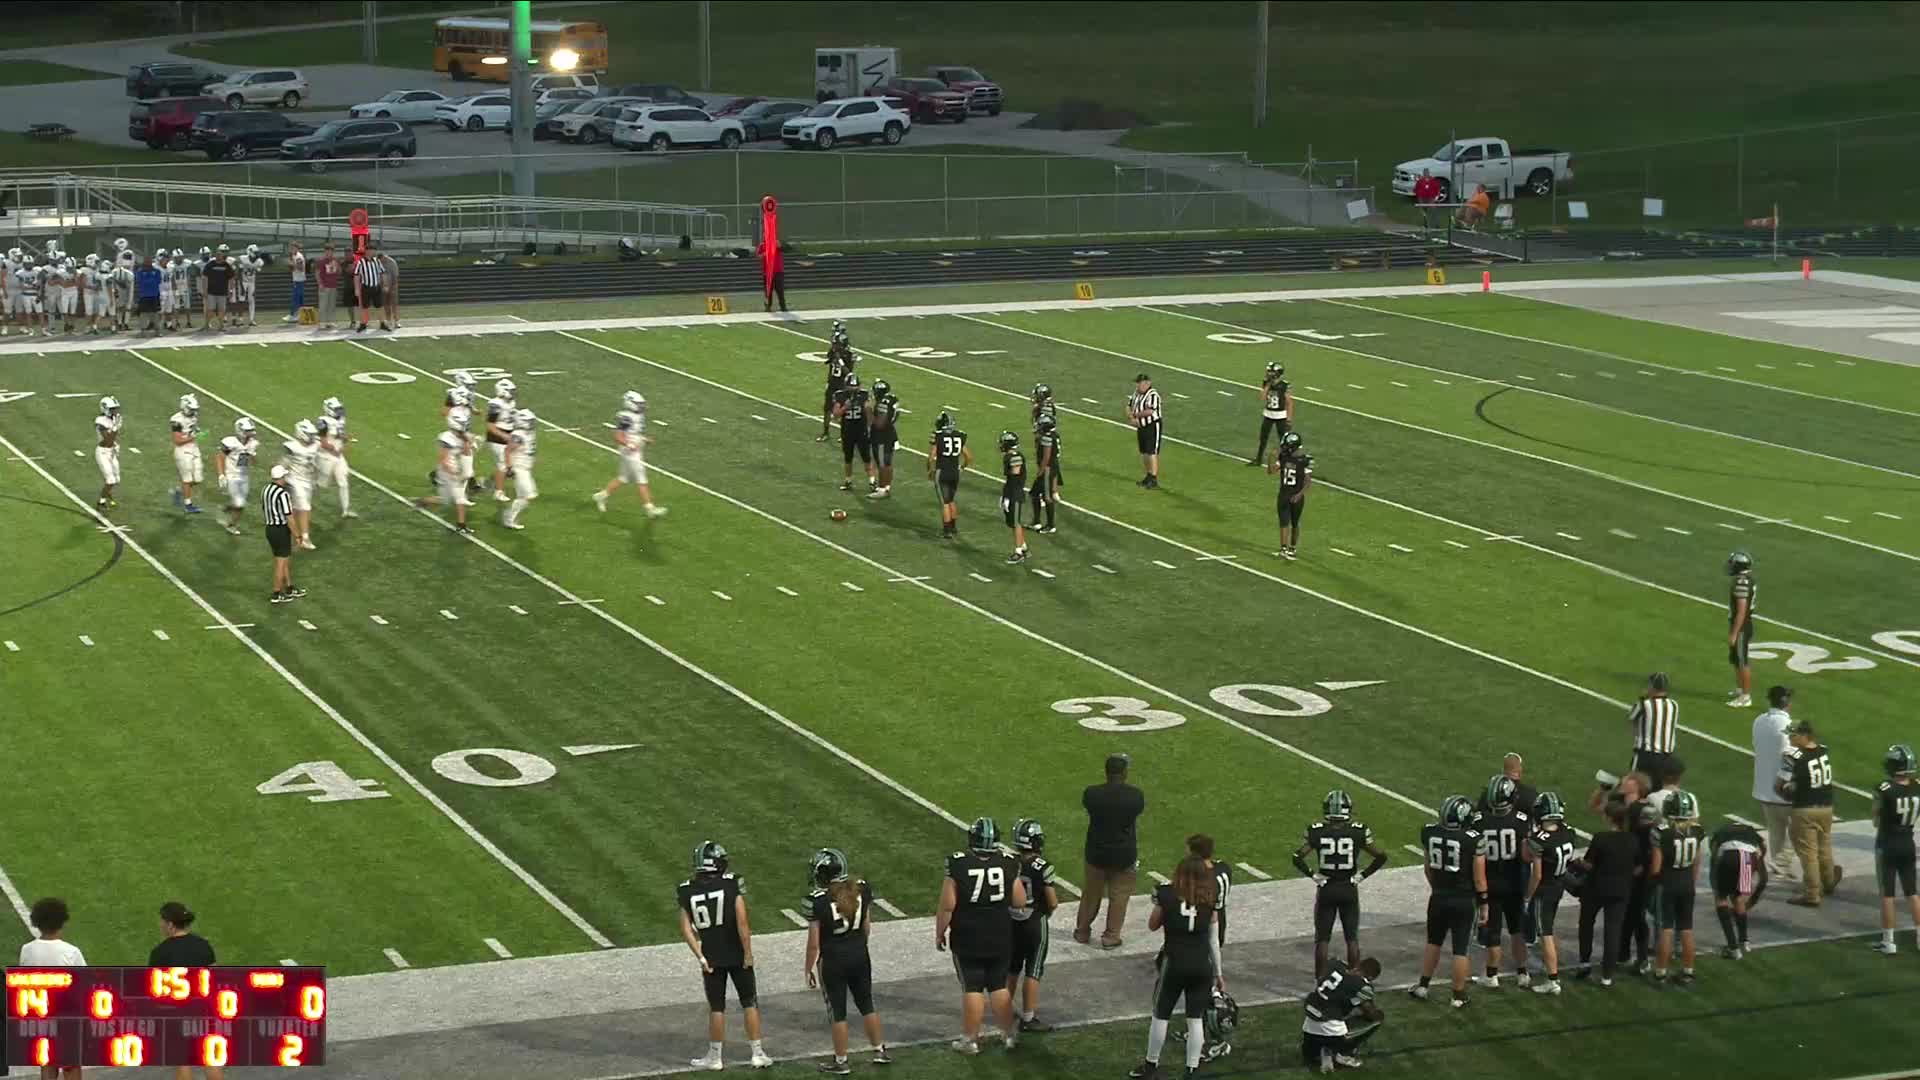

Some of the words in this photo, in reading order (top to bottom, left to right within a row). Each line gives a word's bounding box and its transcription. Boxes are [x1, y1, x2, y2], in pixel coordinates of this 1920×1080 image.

[943, 436, 962, 457] 33
[1808, 754, 1832, 788] 66
[1320, 837, 1354, 870] 29
[1429, 837, 1461, 872] 63
[1483, 828, 1516, 861] 60
[1673, 837, 1697, 868] 10
[967, 867, 1005, 902] 79
[690, 889, 724, 929] 67
[1180, 899, 1198, 932] 4
[1317, 970, 1344, 1001] 2
